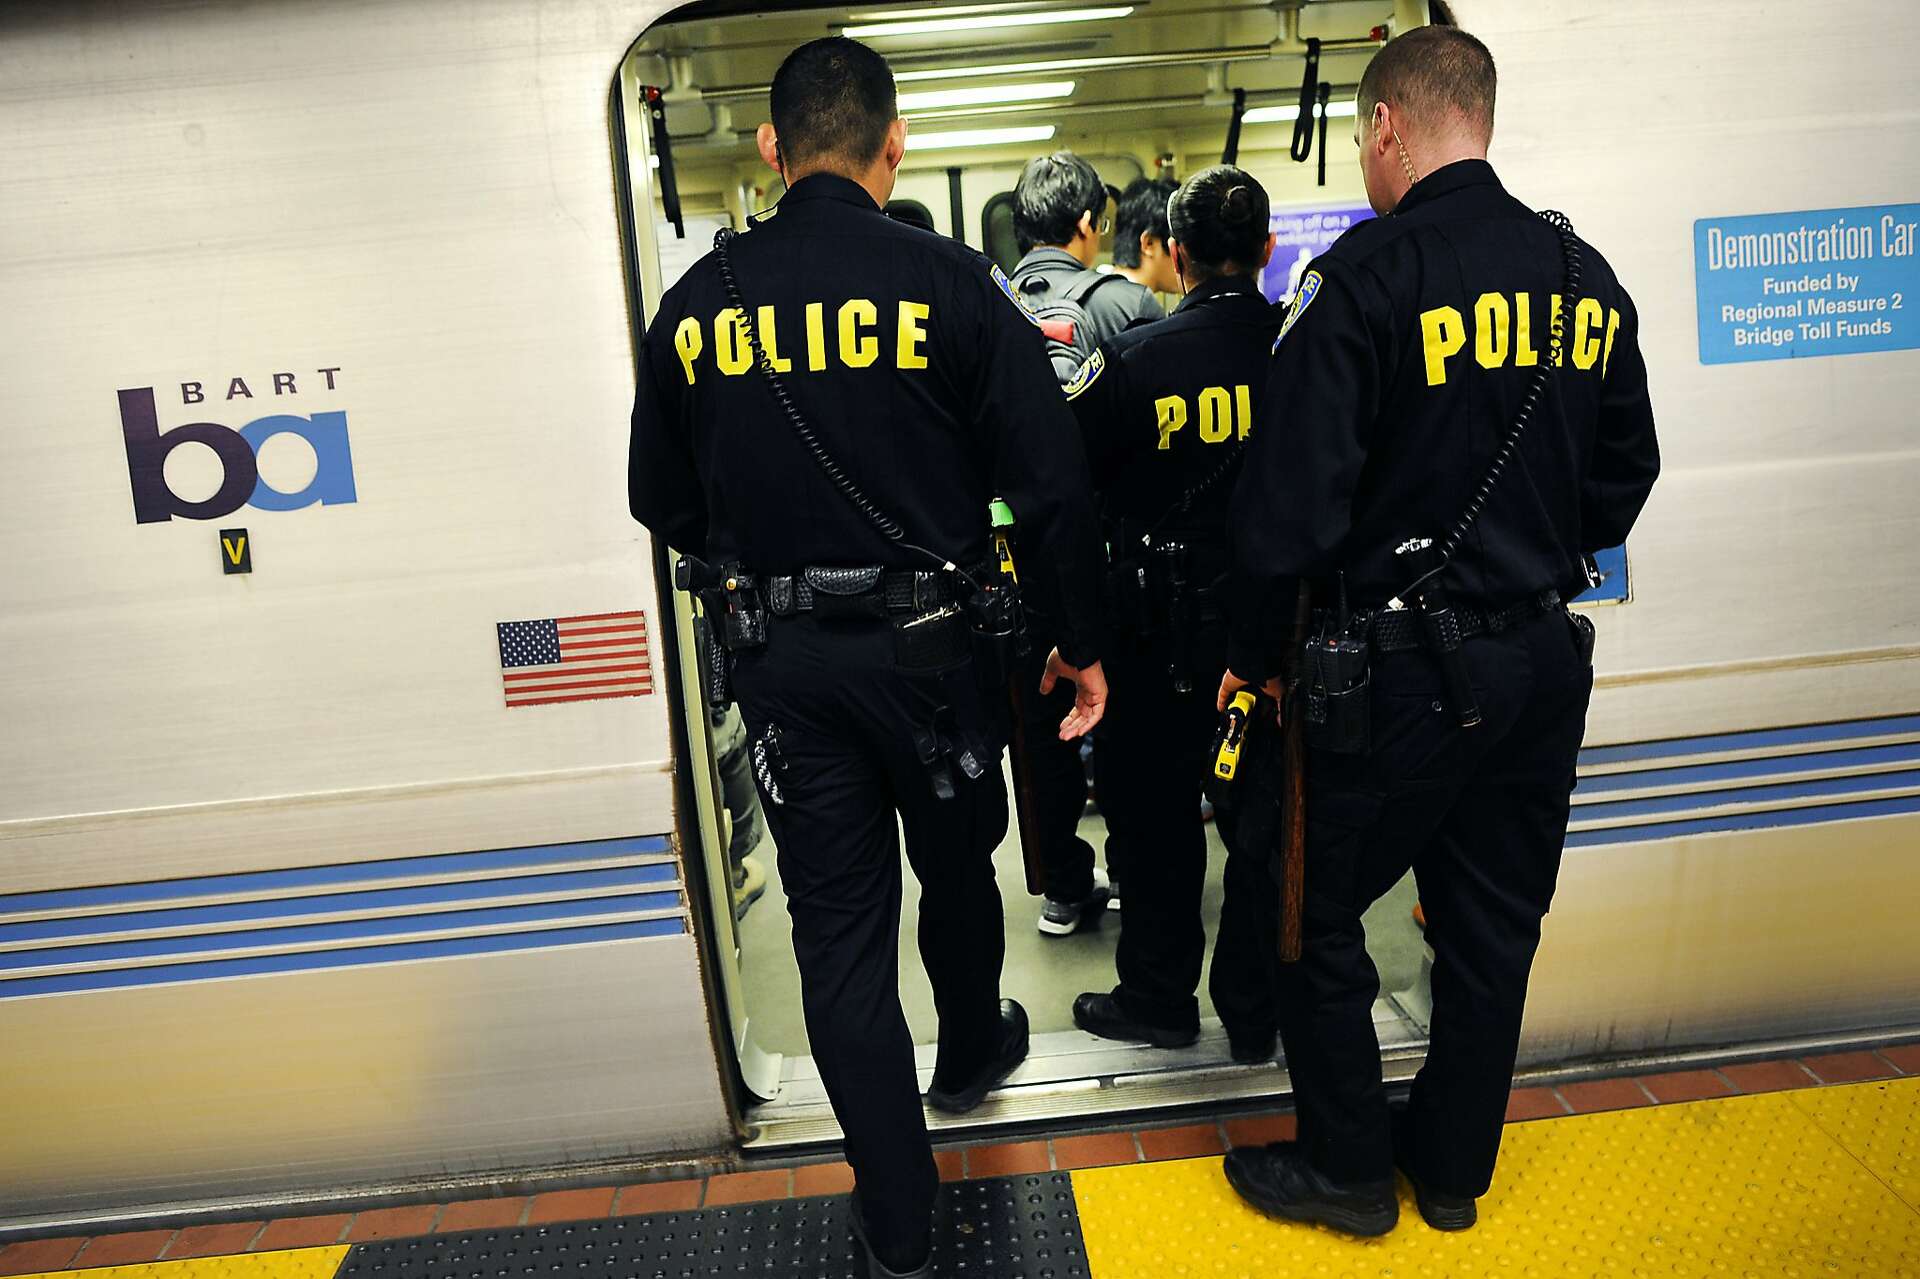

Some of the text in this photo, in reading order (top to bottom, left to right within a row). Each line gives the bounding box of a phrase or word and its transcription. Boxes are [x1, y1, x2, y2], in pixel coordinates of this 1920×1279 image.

[1708, 214, 1918, 271] Demonstration Car
[1762, 272, 1859, 295] Funded by
[1721, 293, 1903, 324] Regional Measure 2
[674, 299, 930, 385] POLICE
[1733, 318, 1892, 346] Bridge Toll Funds
[180, 367, 341, 405] BART
[117, 386, 357, 525] ba
[222, 536, 246, 565] V
